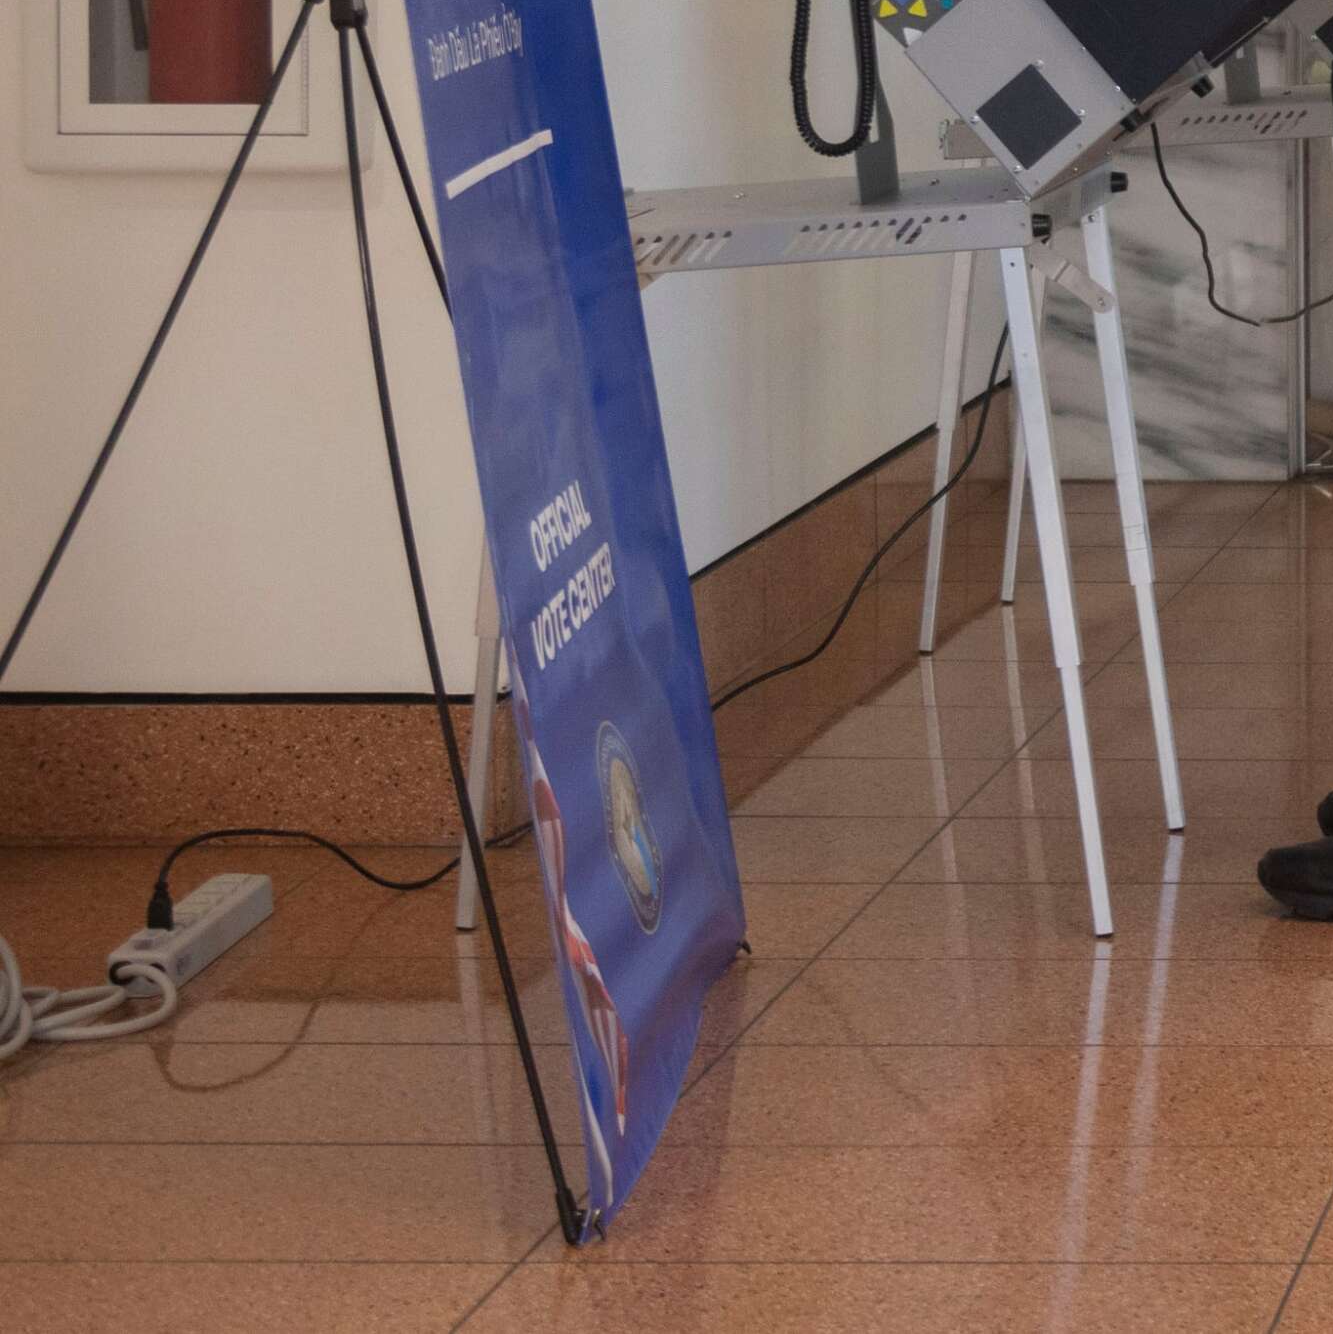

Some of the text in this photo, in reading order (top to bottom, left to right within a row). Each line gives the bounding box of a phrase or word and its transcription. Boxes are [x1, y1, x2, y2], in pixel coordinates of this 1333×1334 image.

[530, 480, 592, 572] OFFICIAL
[531, 542, 616, 670] VOTE CENTER
